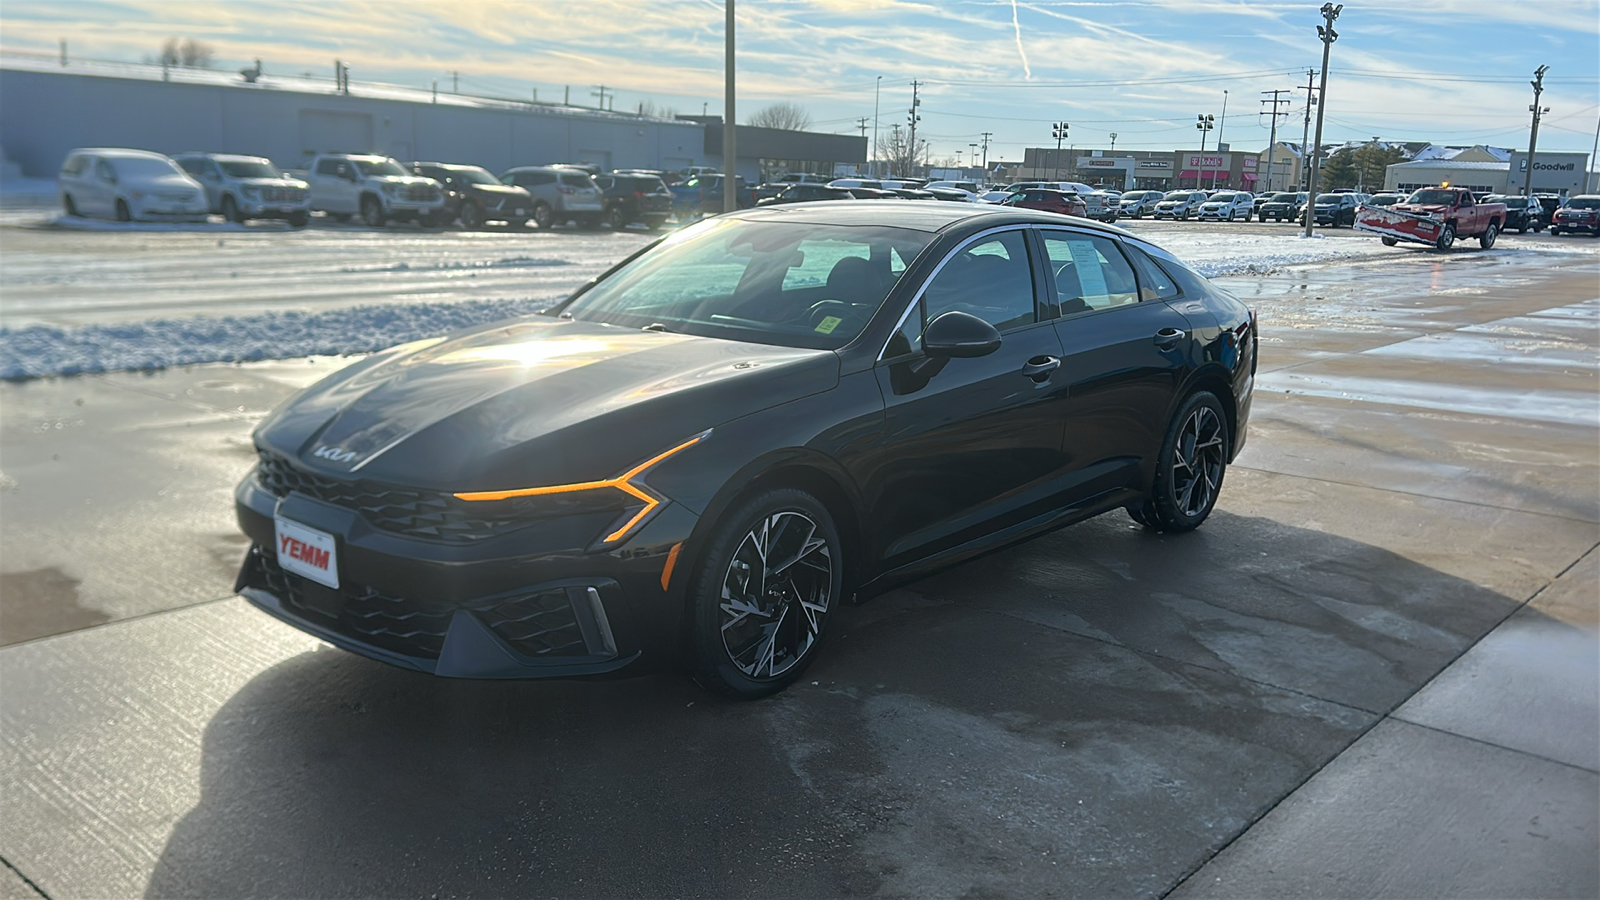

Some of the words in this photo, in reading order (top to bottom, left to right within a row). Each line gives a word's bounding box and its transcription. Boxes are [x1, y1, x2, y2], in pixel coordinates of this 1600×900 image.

[1533, 162, 1575, 171] Goodwill
[314, 446, 356, 463] KIA
[279, 533, 330, 571] YEMM
